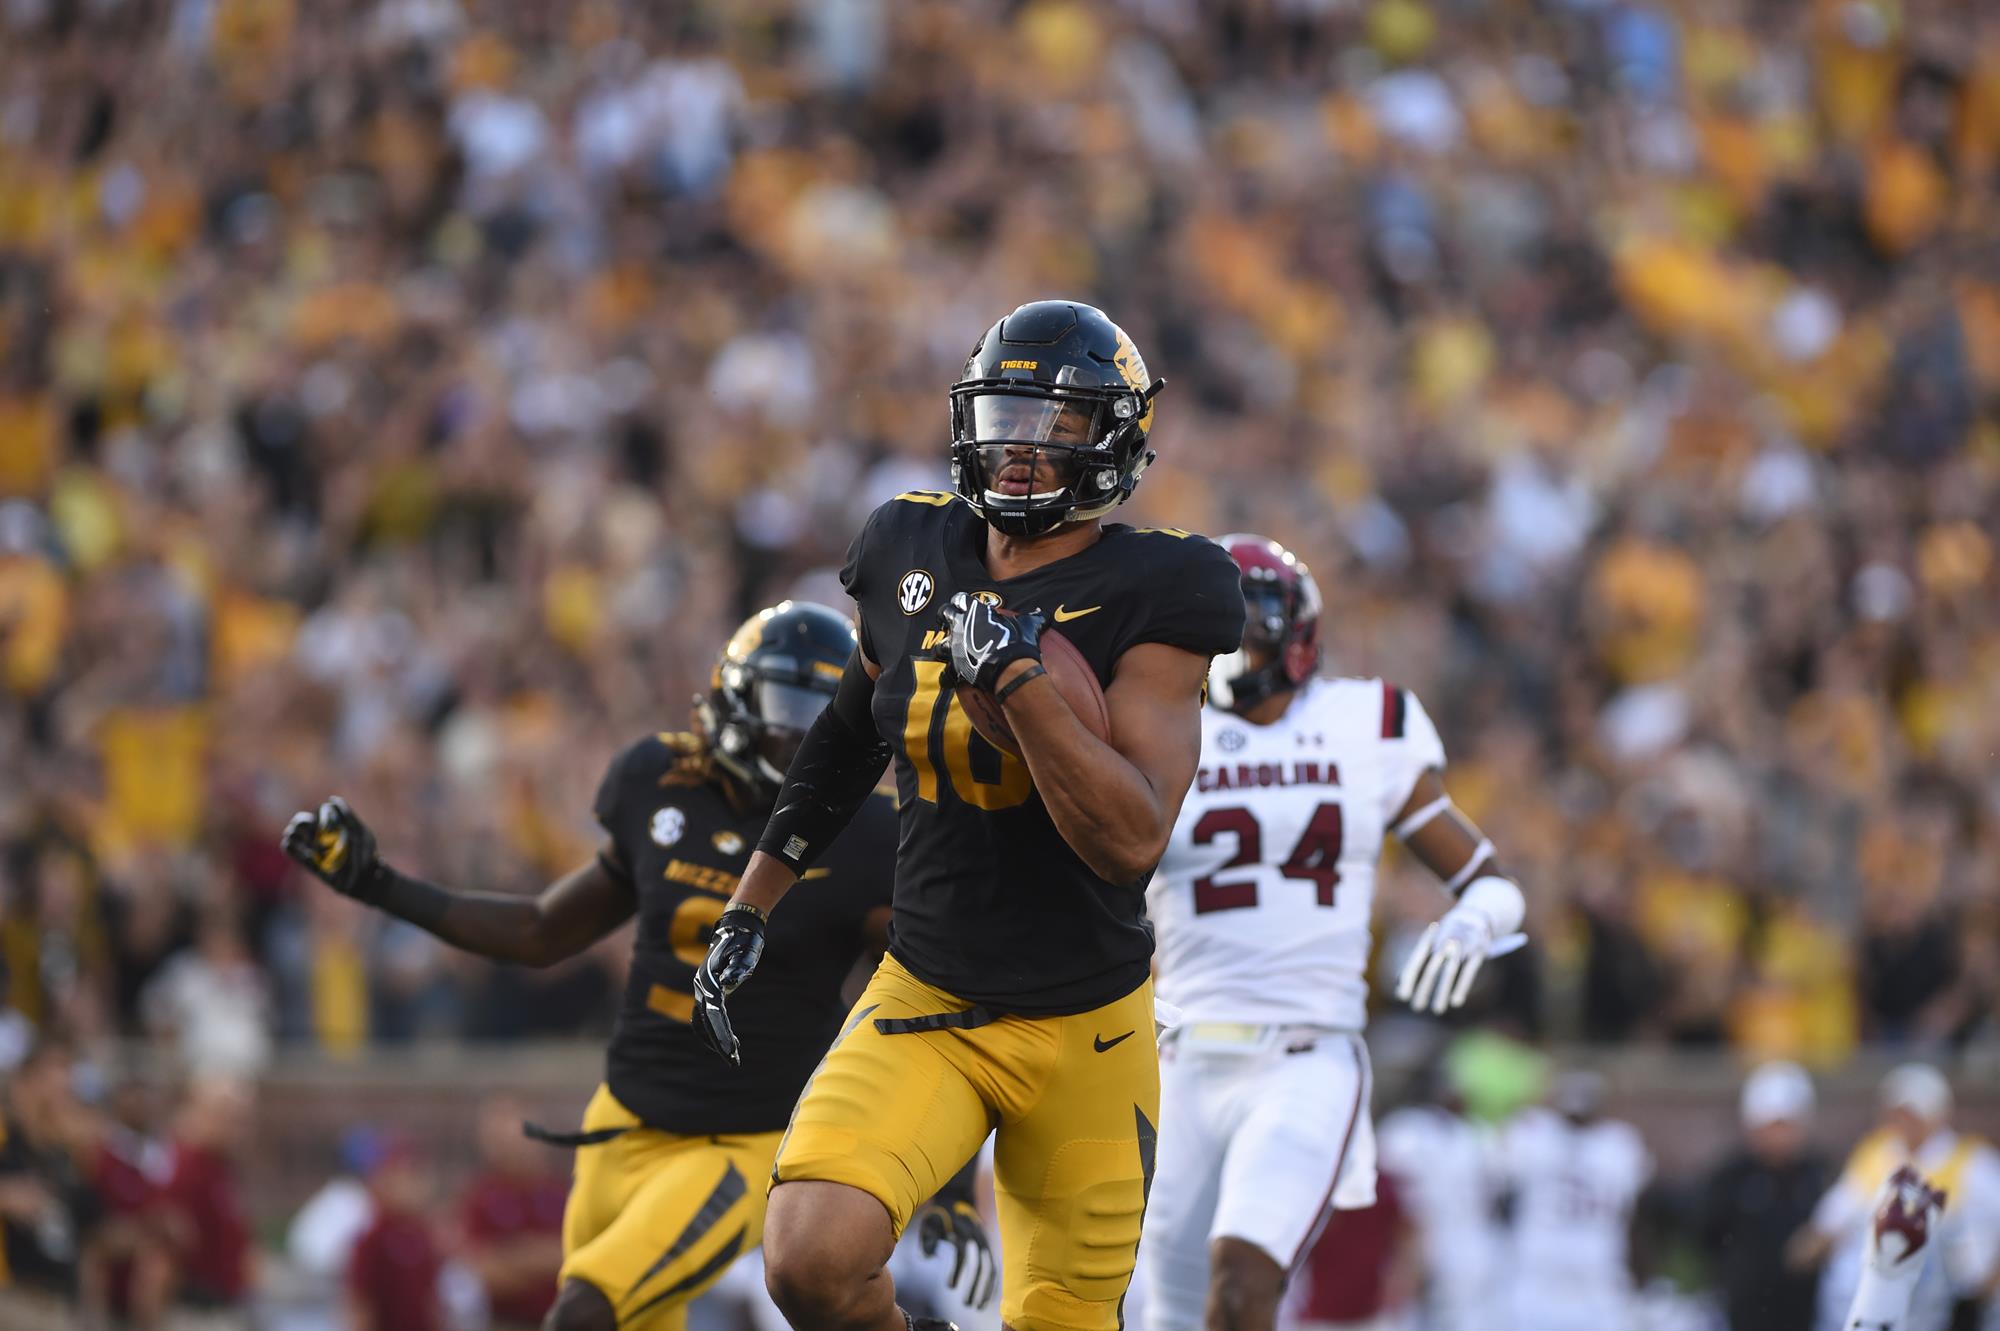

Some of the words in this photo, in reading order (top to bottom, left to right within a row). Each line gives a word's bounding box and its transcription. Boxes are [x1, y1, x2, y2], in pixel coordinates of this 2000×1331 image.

[1000, 360, 1038, 371] TIGERS
[900, 572, 932, 612] SEC
[1196, 761, 1342, 793] CAROLINA
[664, 858, 738, 897] MIZZO
[1191, 802, 1344, 917] 24
